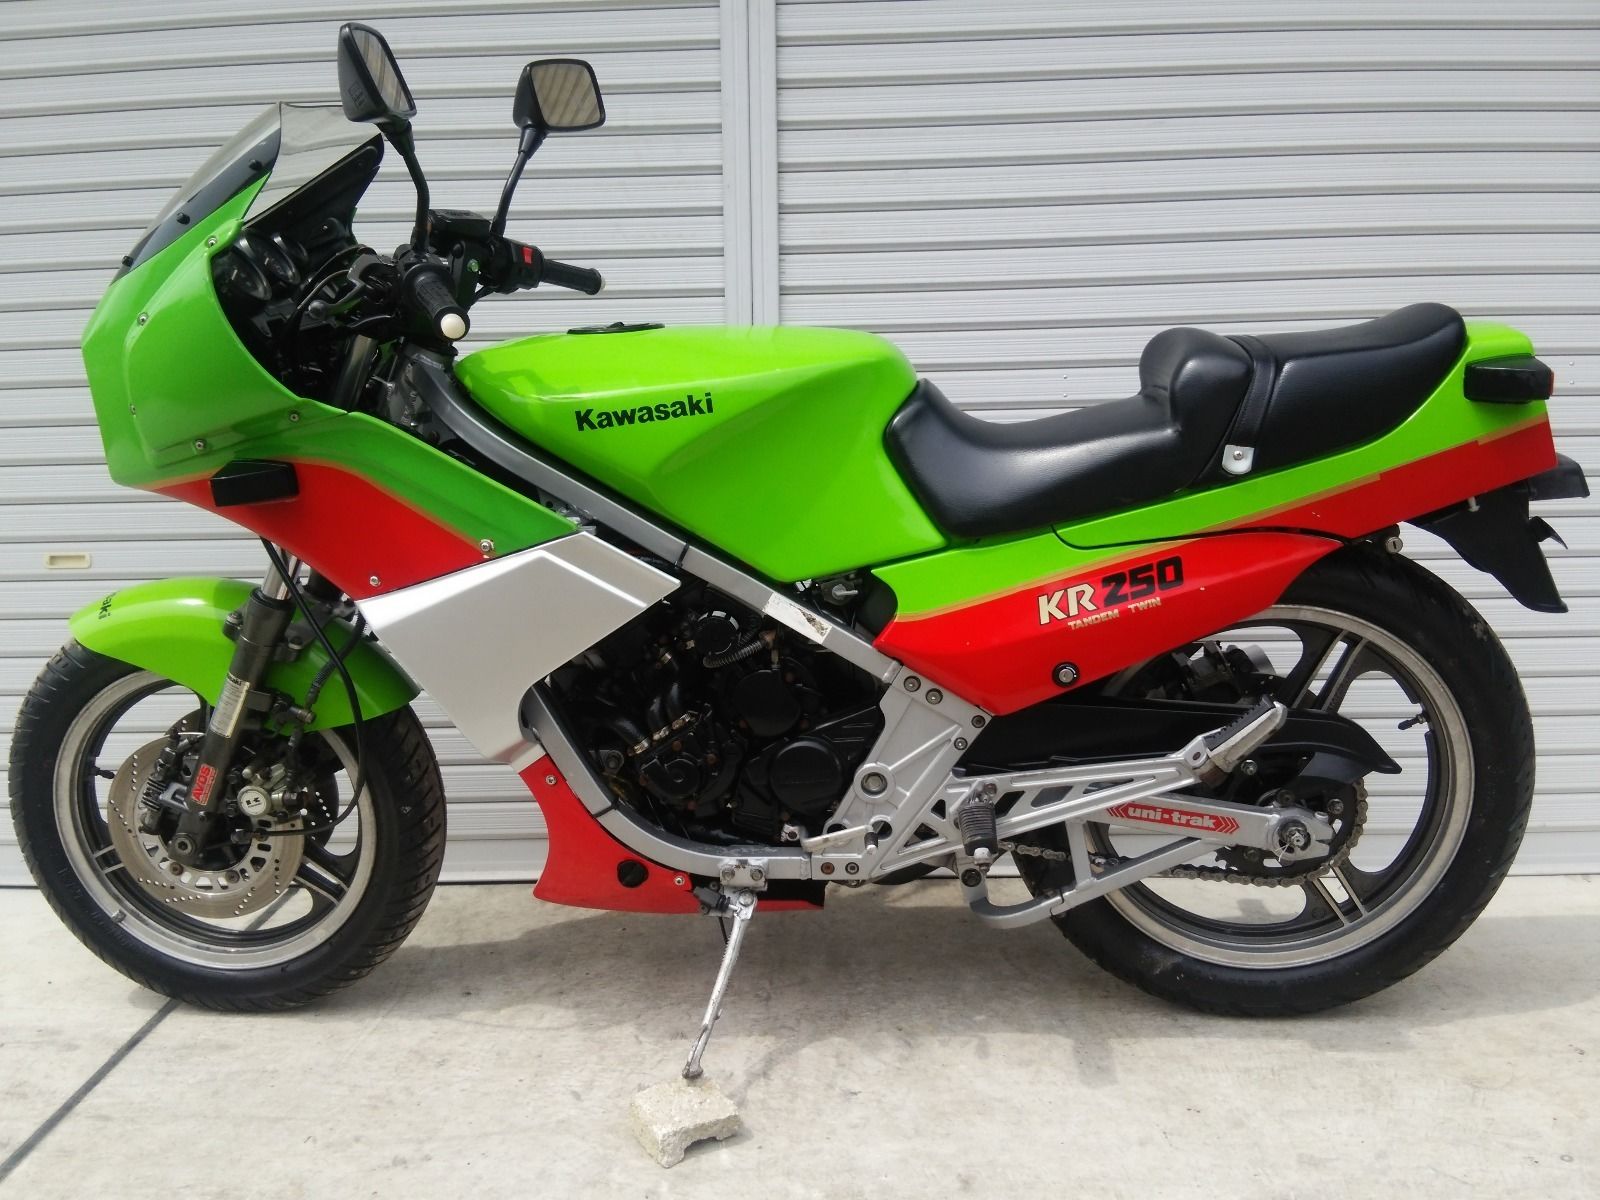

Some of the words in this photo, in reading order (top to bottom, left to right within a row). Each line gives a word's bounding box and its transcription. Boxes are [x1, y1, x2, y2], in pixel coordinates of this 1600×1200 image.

[575, 392, 714, 431] Kawasaki
[1037, 582, 1099, 626] KR
[1101, 555, 1184, 607] 250
[1067, 608, 1120, 630] TANDEM
[1128, 596, 1162, 614] TWIN
[1127, 806, 1217, 828] uni-trak
